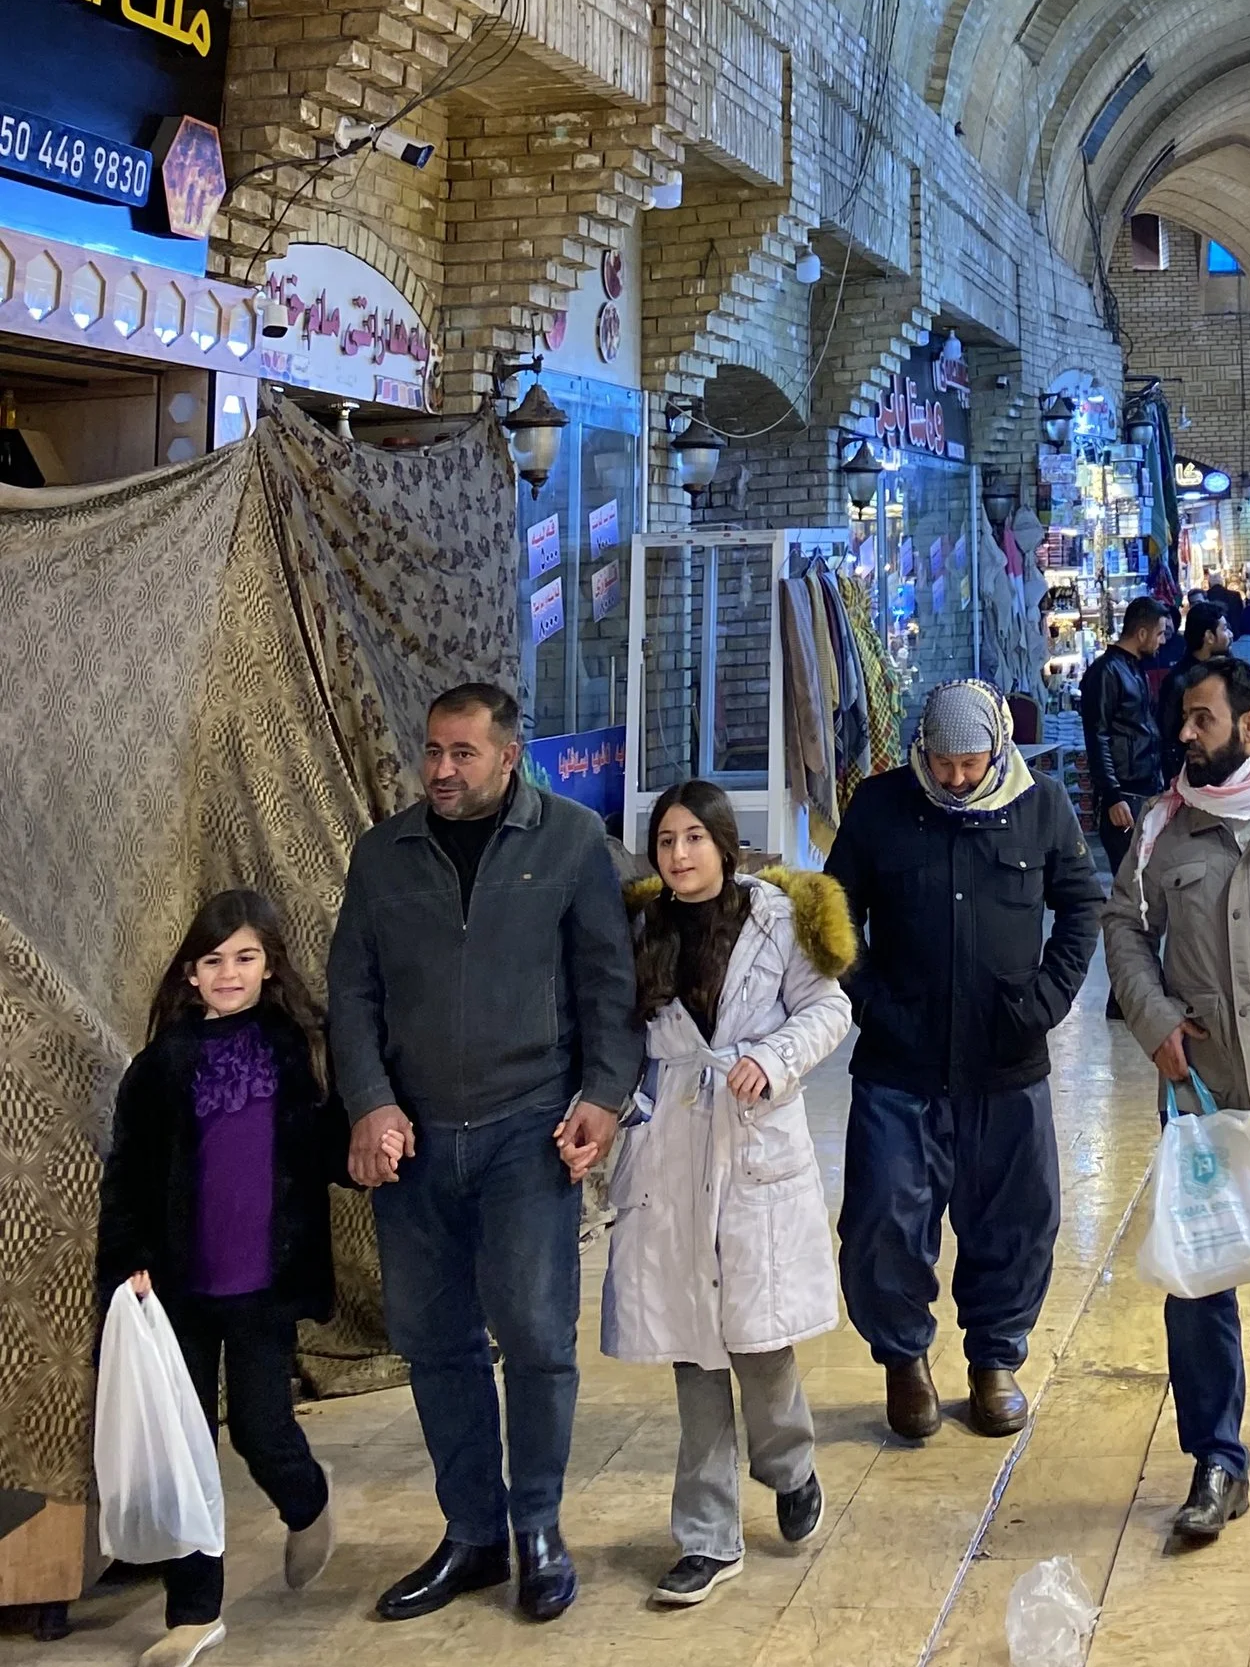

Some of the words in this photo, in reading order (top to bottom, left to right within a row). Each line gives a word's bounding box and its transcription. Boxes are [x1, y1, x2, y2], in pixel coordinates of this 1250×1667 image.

[0, 115, 31, 163] 50
[38, 129, 86, 180] 448
[94, 146, 148, 198] 9830
